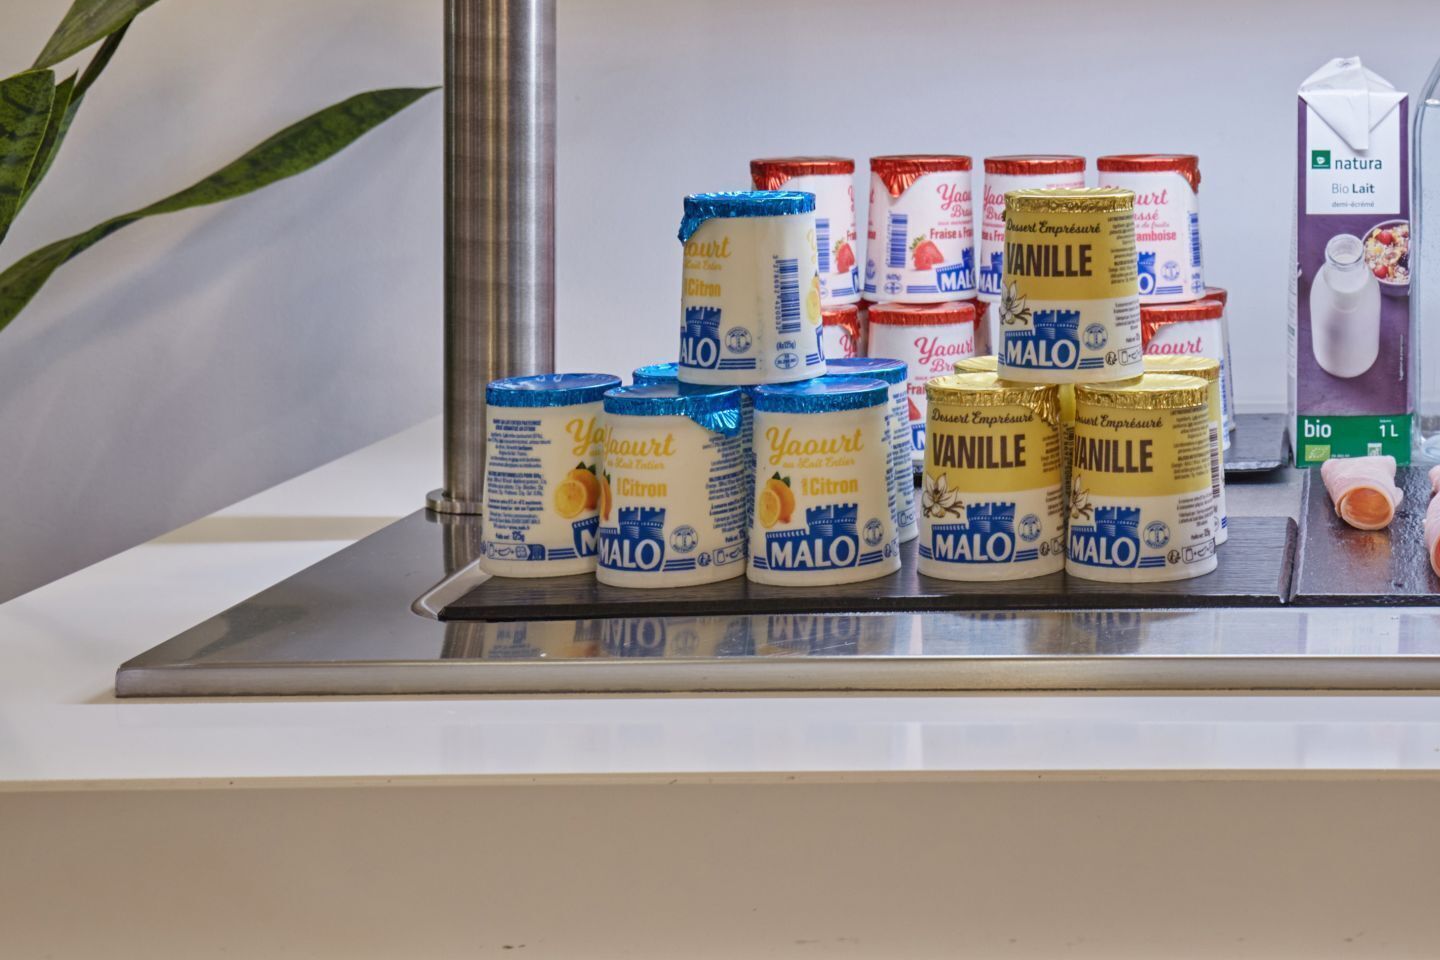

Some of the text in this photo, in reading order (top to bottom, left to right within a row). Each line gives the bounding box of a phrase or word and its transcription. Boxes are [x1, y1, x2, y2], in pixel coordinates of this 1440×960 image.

[1335, 157, 1383, 170] natura
[1332, 183, 1375, 194] Bio Lait
[929, 228, 957, 239] Fraise
[1039, 220, 1101, 237] Emprésuré
[1136, 230, 1177, 241] amboise
[1007, 241, 1092, 277] VANILLE
[688, 278, 721, 296] Citron
[681, 337, 717, 367] ALO
[1007, 339, 1077, 368] MALO
[1147, 336, 1204, 355] aourt
[931, 408, 1034, 428] Dessert Emprésuré
[1100, 414, 1163, 432] Emprésuré
[1304, 419, 1332, 438] bio
[1379, 424, 1399, 438] 1 L
[765, 426, 864, 465] Yaourt
[932, 432, 1026, 469] VANILLE
[622, 477, 668, 497] Citron
[810, 477, 859, 496] Citron
[771, 535, 856, 568] MALO
[935, 532, 1012, 561] MALO
[1072, 534, 1137, 567] MALO
